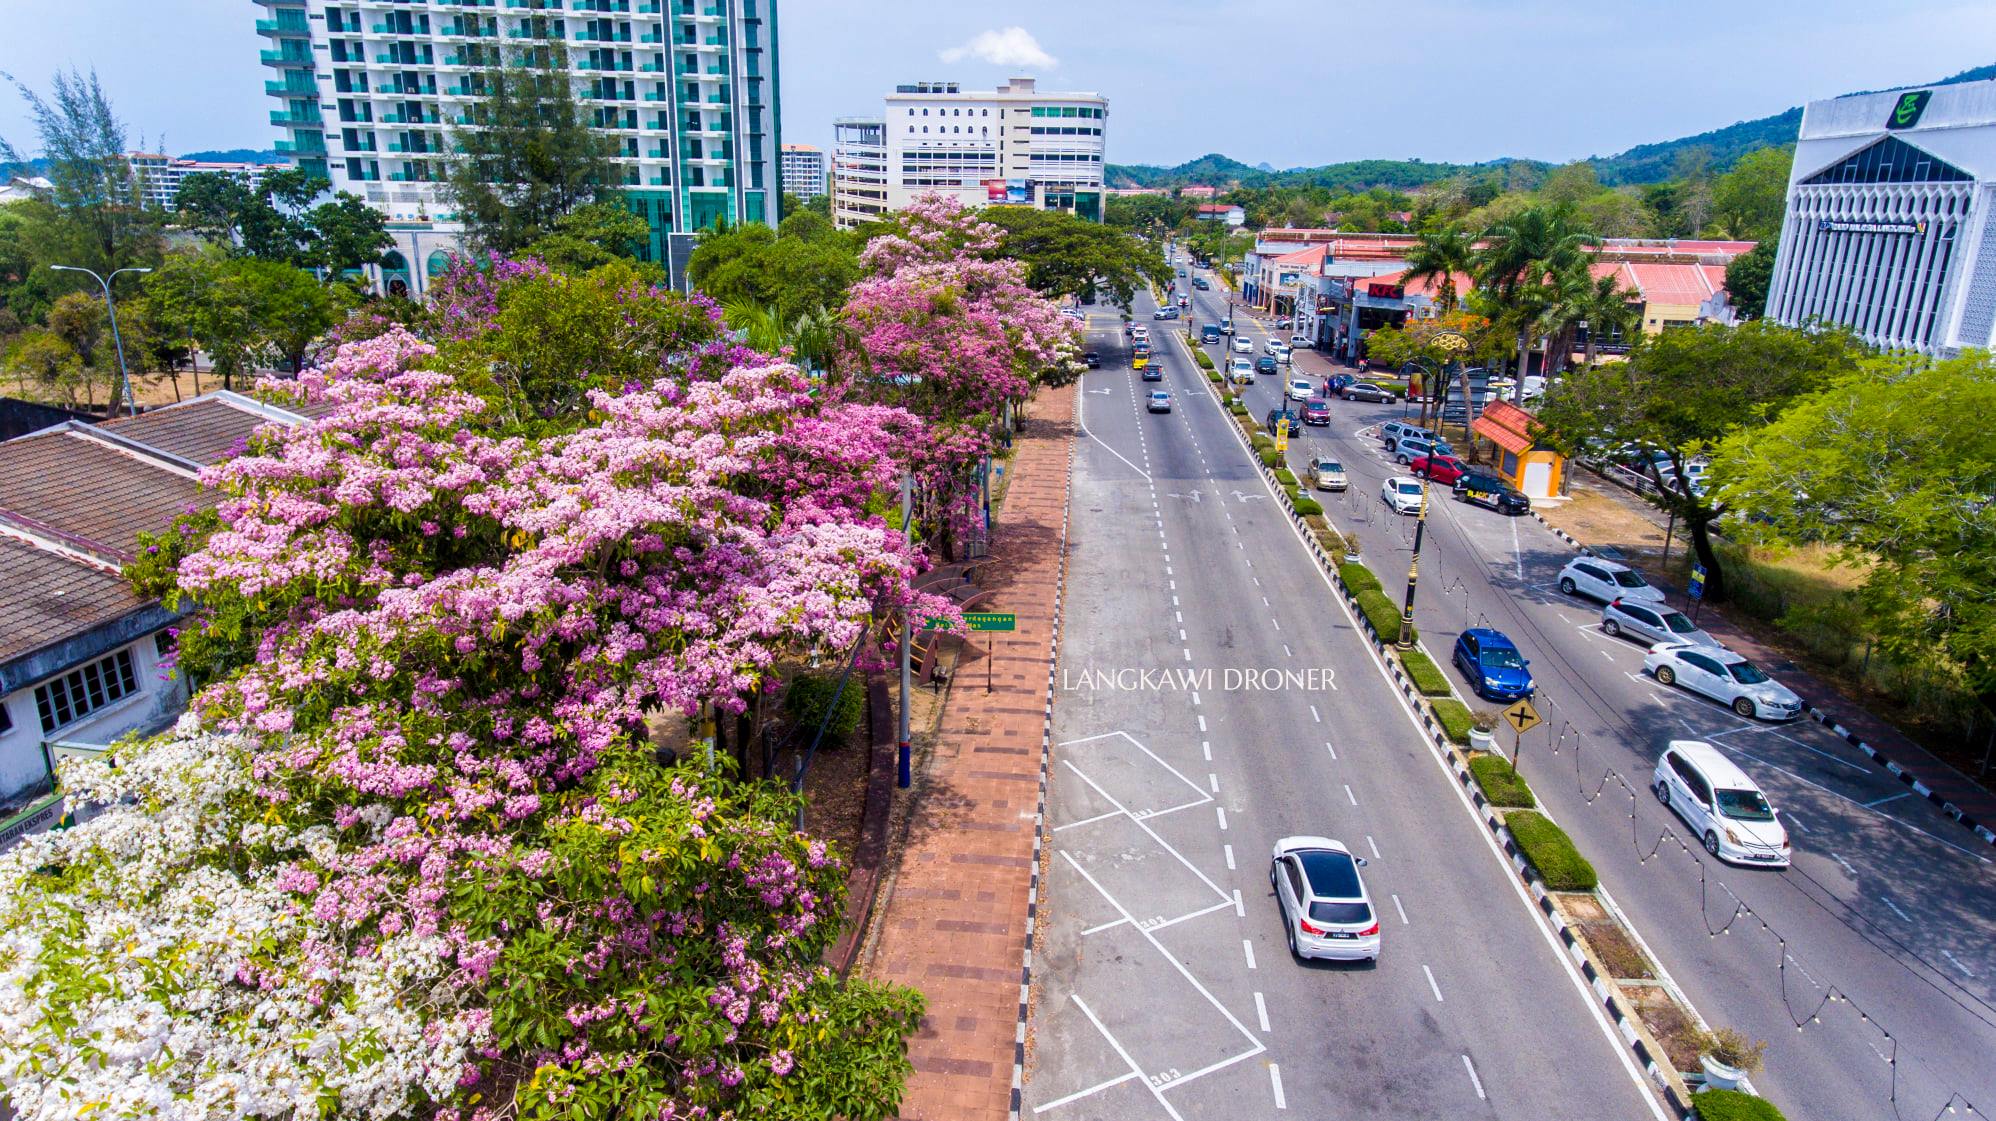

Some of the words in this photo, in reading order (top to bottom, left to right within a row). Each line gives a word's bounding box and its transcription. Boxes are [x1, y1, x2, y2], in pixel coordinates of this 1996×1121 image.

[1370, 284, 1399, 299] KFC
[24, 808, 54, 831] EKSPRES
[1150, 1067, 1182, 1087] 303
